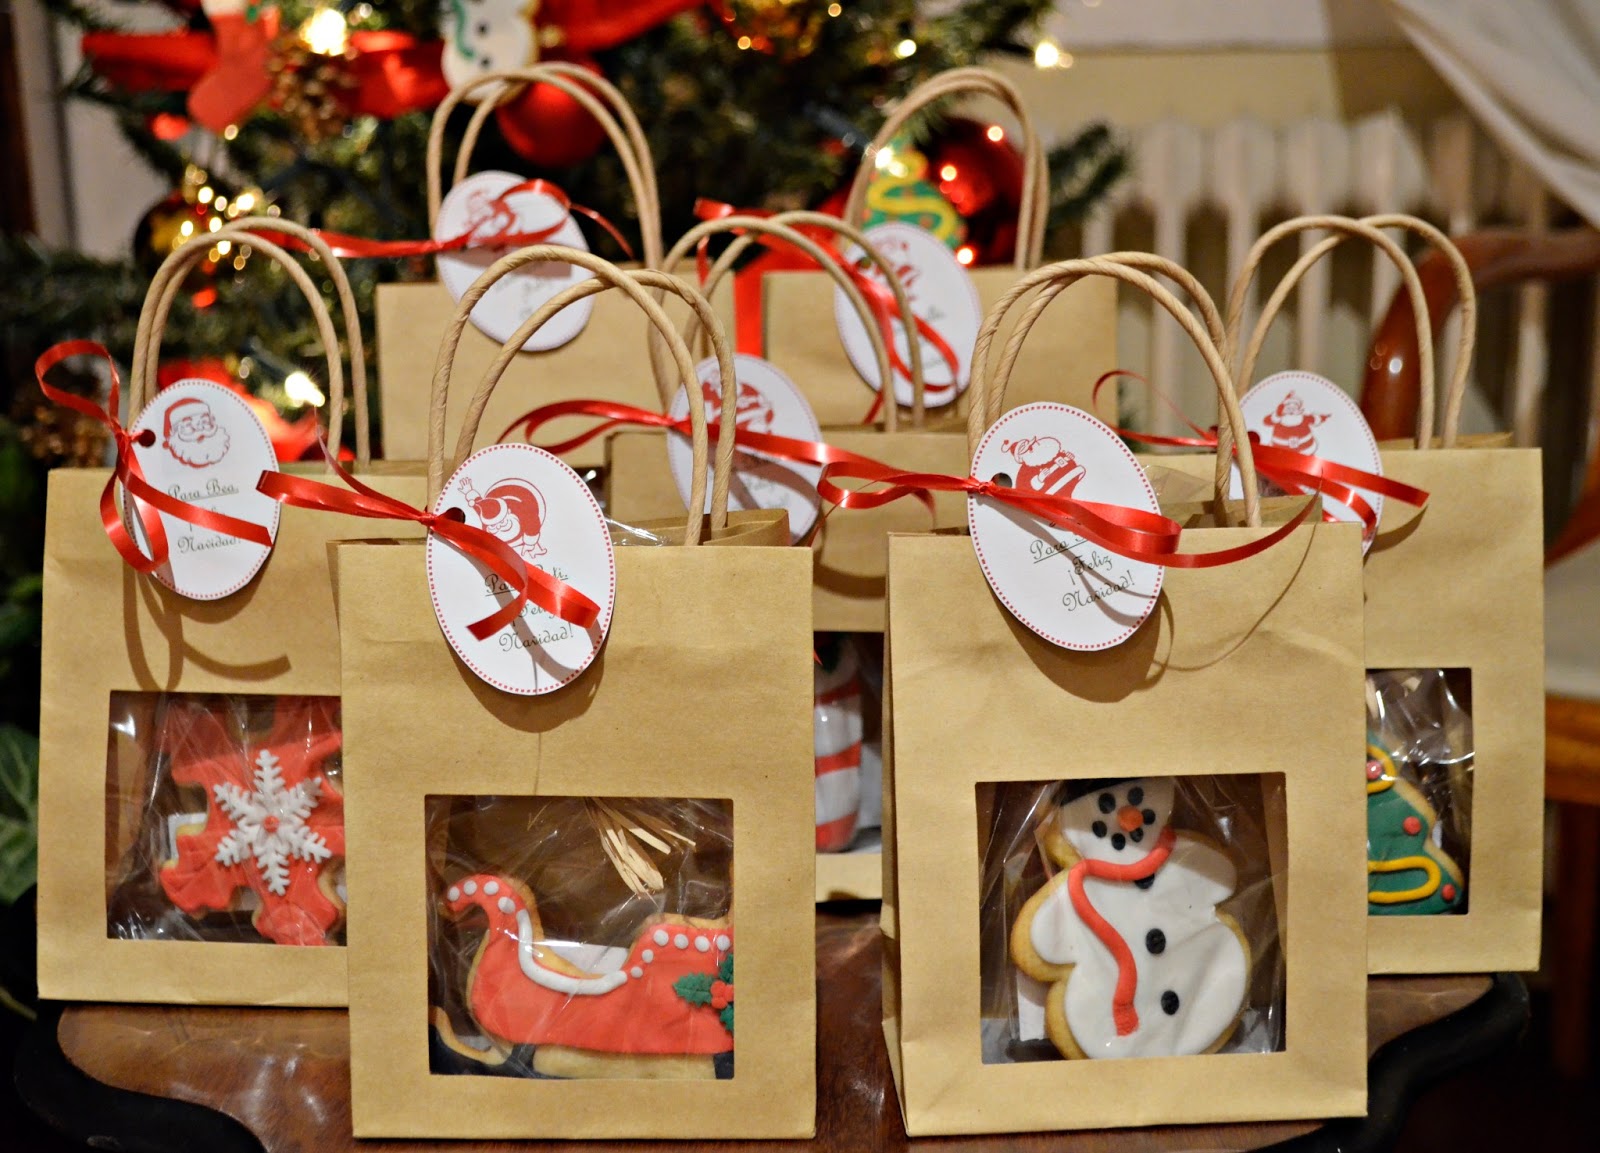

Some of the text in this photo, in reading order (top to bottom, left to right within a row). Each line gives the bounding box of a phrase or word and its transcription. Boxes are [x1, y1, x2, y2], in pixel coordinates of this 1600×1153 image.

[168, 484, 201, 502] Para
[1030, 539, 1069, 562] Para
[484, 573, 516, 596] Pa
[1062, 569, 1136, 612] Navidad!
[498, 622, 574, 653] Navidad!
